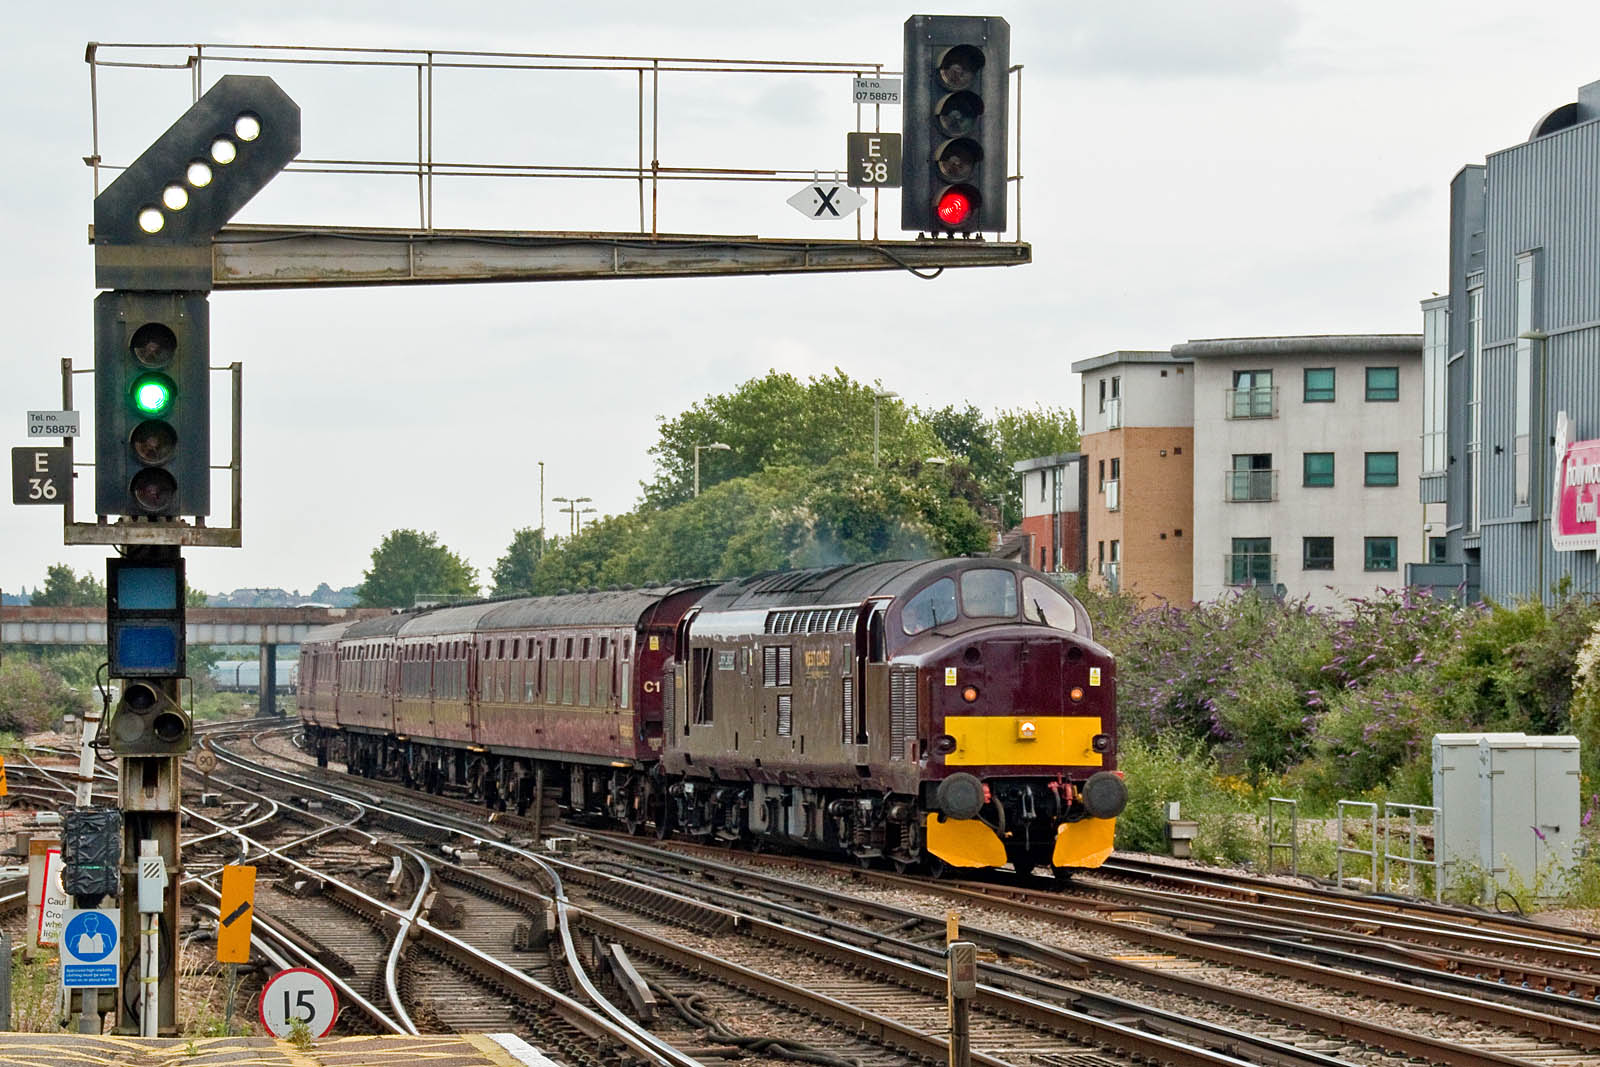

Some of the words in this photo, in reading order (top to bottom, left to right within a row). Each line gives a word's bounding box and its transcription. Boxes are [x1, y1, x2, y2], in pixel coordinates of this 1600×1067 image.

[856, 92, 868, 100] 07
[869, 92, 898, 101] 58875
[868, 138, 881, 157] E
[862, 163, 888, 183] 38
[813, 187, 840, 216] X
[30, 425, 44, 434] 07
[45, 425, 77, 434] 58875
[35, 452, 49, 473] E
[28, 478, 57, 500] 36
[643, 680, 660, 693] C1
[283, 989, 316, 1026] 15
